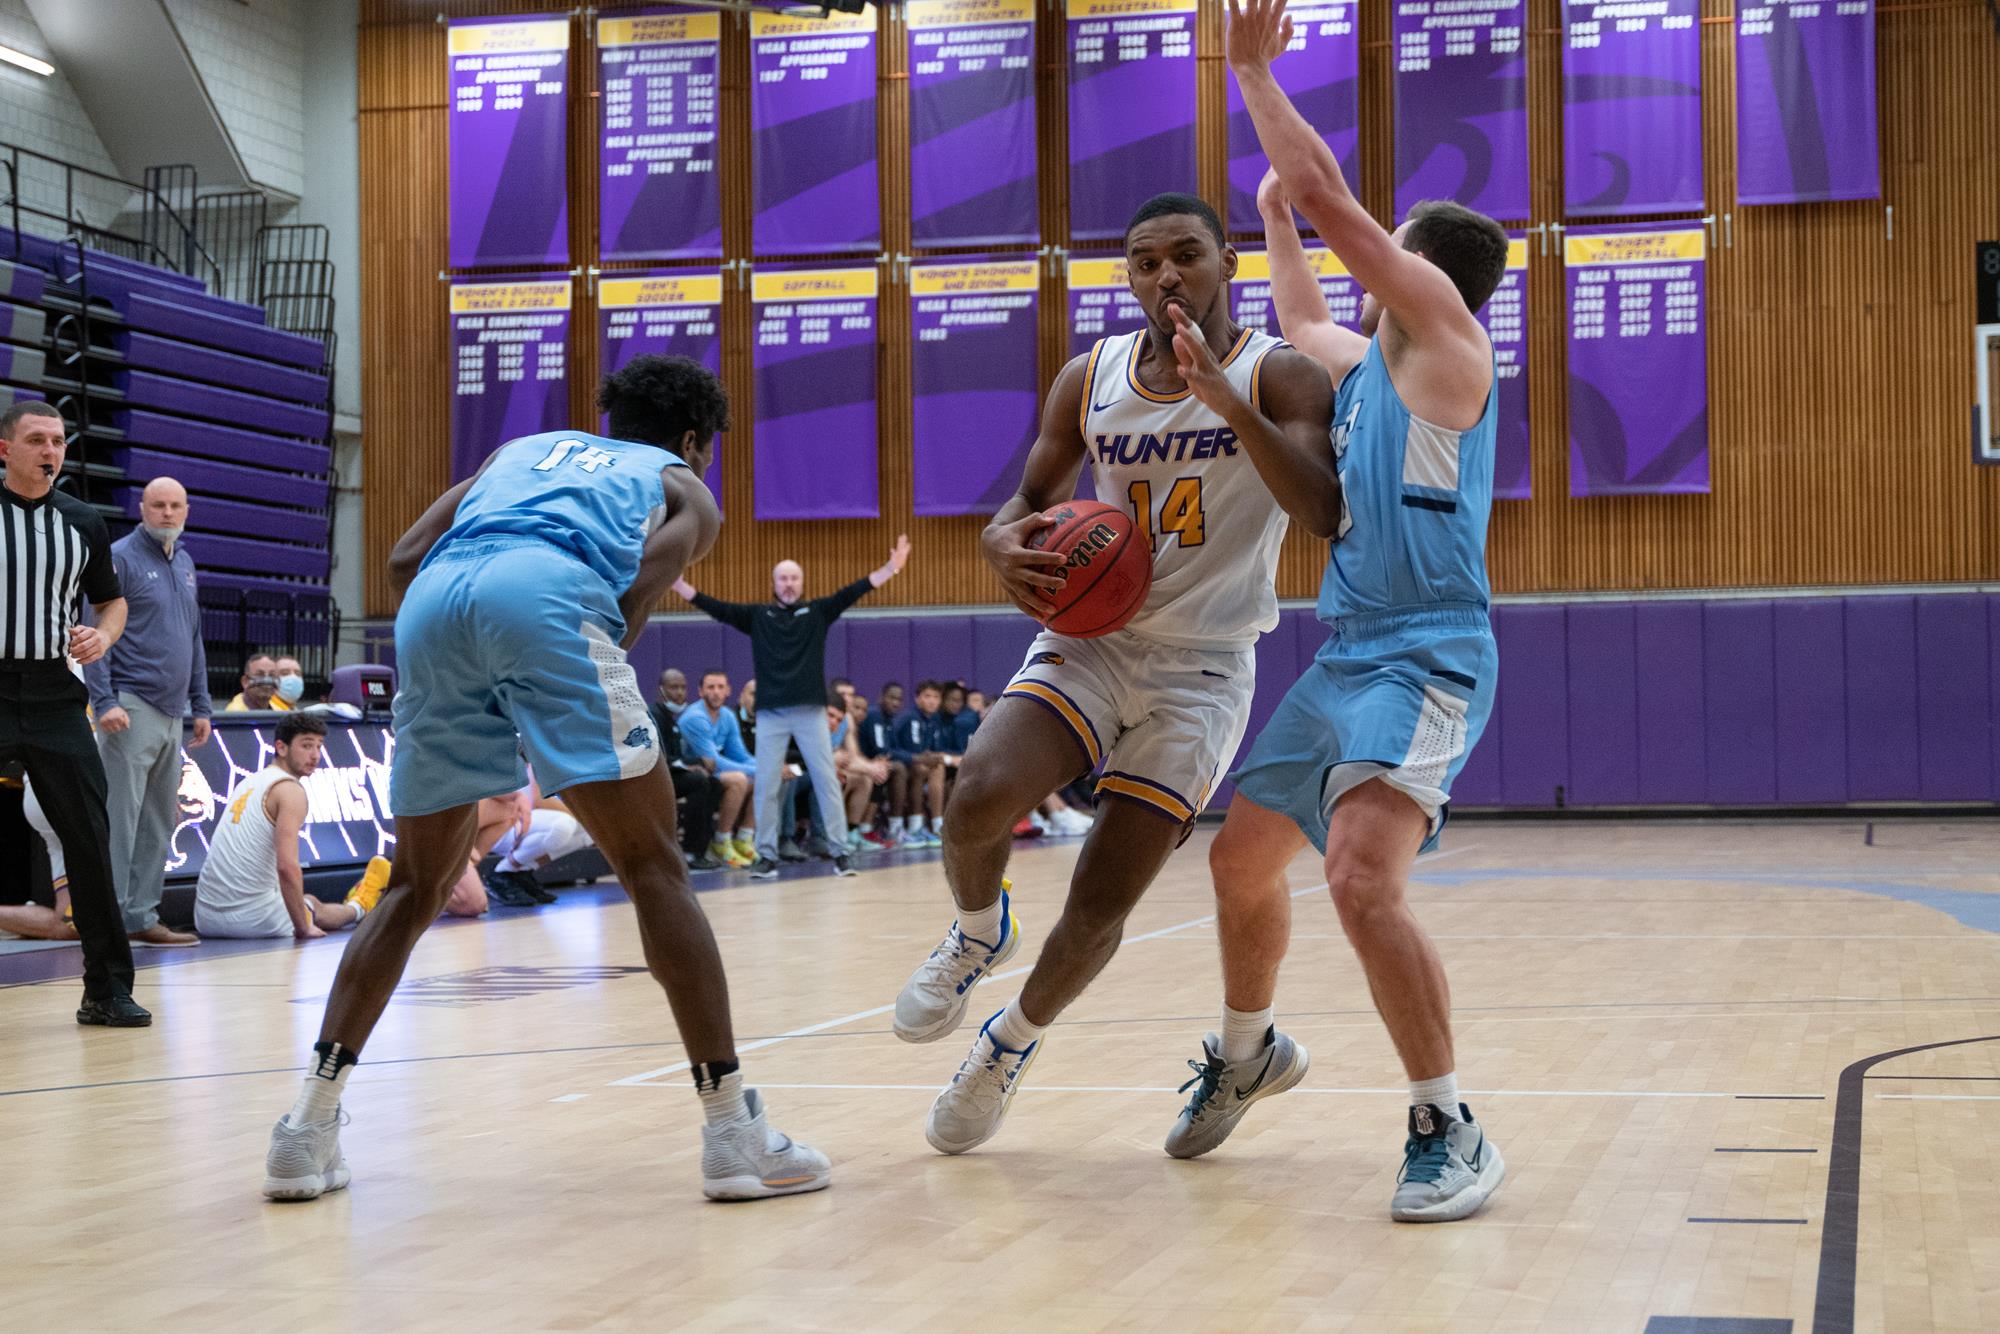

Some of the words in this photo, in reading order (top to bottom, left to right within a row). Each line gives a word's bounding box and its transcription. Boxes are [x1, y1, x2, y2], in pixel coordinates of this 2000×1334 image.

[631, 17, 688, 29] WOMEN'S
[631, 30, 687, 41] FENCING
[639, 46, 716, 60] CHAMPIONSHIP
[626, 62, 691, 76] APPEARANCE
[606, 135, 633, 148] NCAA
[636, 132, 714, 147] CHAMPIONSHIP
[627, 147, 692, 161] APPEARANCE
[1603, 236, 1665, 248] WOMEN'S
[918, 268, 968, 281] WOMEN'S
[641, 281, 679, 291] MEN'S
[783, 280, 846, 291] SOFTBALL
[942, 281, 965, 290] AND
[968, 279, 1008, 290] DIVING
[455, 287, 506, 299] WOMEN'S
[511, 285, 565, 296] OUTDOOR
[636, 293, 685, 303] SOCCER
[466, 298, 503, 309] TRACK
[520, 297, 555, 307] FIELD
[764, 306, 792, 318] NCAA
[796, 302, 866, 316] TOURNAMENT
[918, 300, 947, 313] NCAA
[950, 296, 1032, 311] CHAMPIONSHIP
[457, 317, 485, 329] NCAA
[488, 314, 564, 328] CHAMPIONSHIP
[610, 312, 638, 325] NCAA
[642, 309, 711, 322] TOURNAMENT
[940, 311, 1009, 326] APPEARANCE
[478, 328, 542, 342] APPEARANCE
[1090, 427, 1238, 465] HUNTER
[531, 439, 620, 473] 14
[1128, 476, 1206, 553] 14
[230, 788, 253, 824] 4
